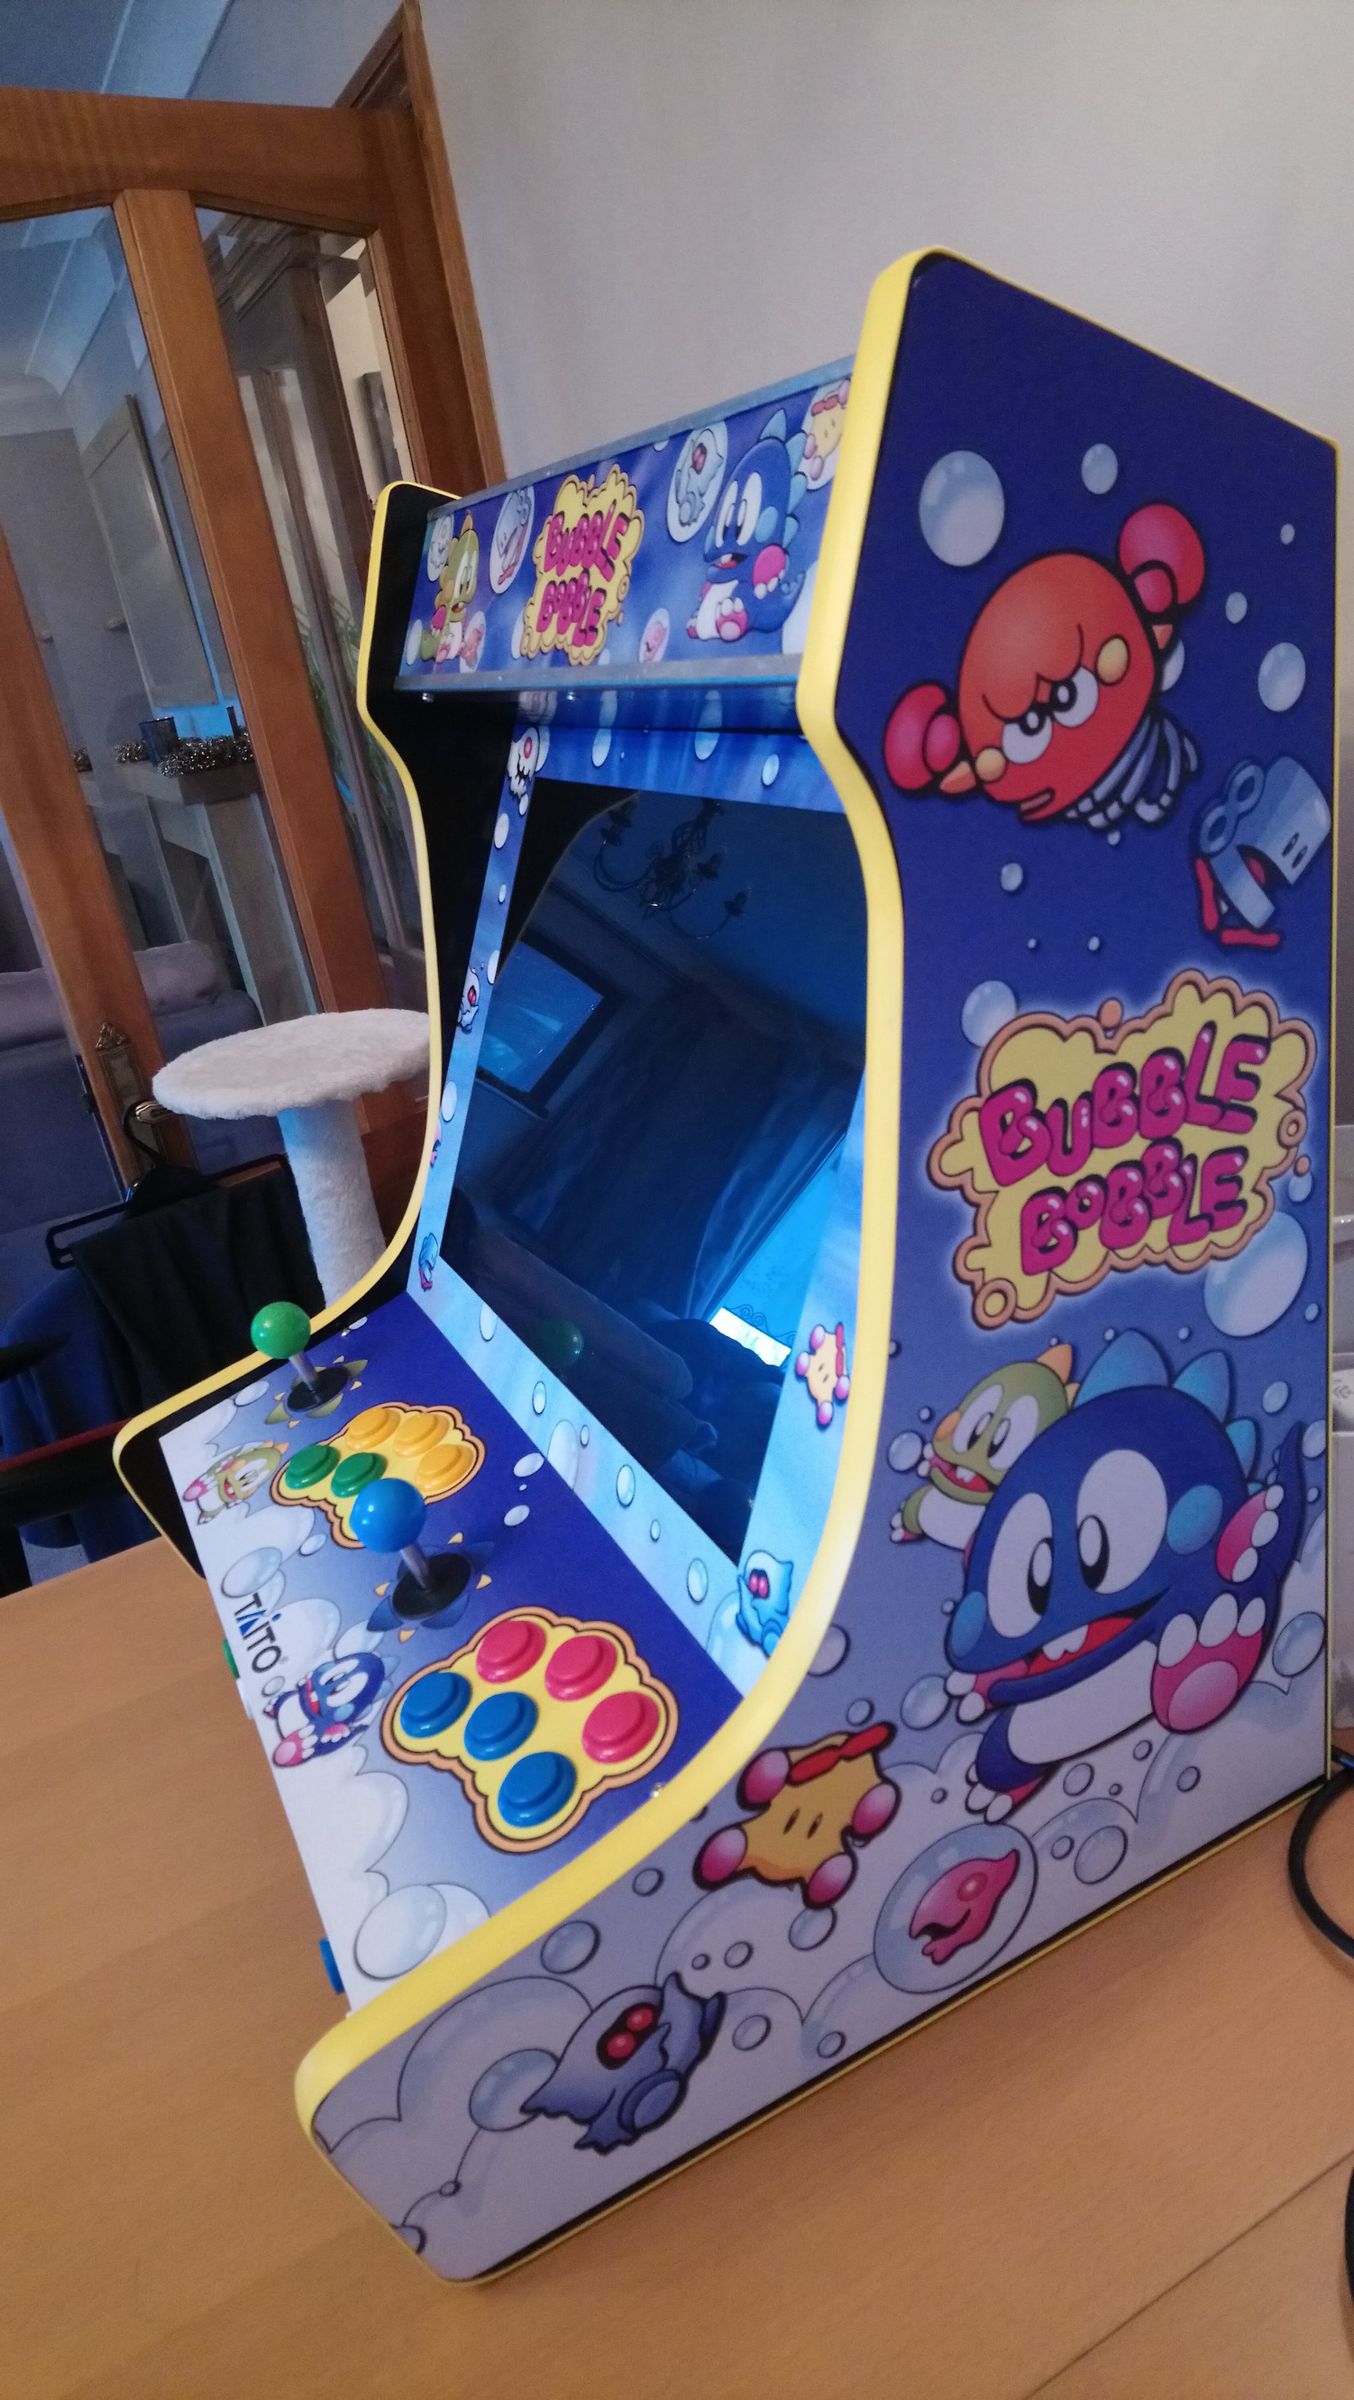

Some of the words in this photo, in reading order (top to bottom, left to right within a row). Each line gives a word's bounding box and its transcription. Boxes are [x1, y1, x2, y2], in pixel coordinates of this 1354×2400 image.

[544, 500, 630, 582] BUBBLE
[536, 568, 607, 647] BOBBLE
[978, 1021, 1271, 1187] BUBBLE
[1020, 1137, 1249, 1276] BOBBLE
[234, 1592, 282, 1673] TAITO
